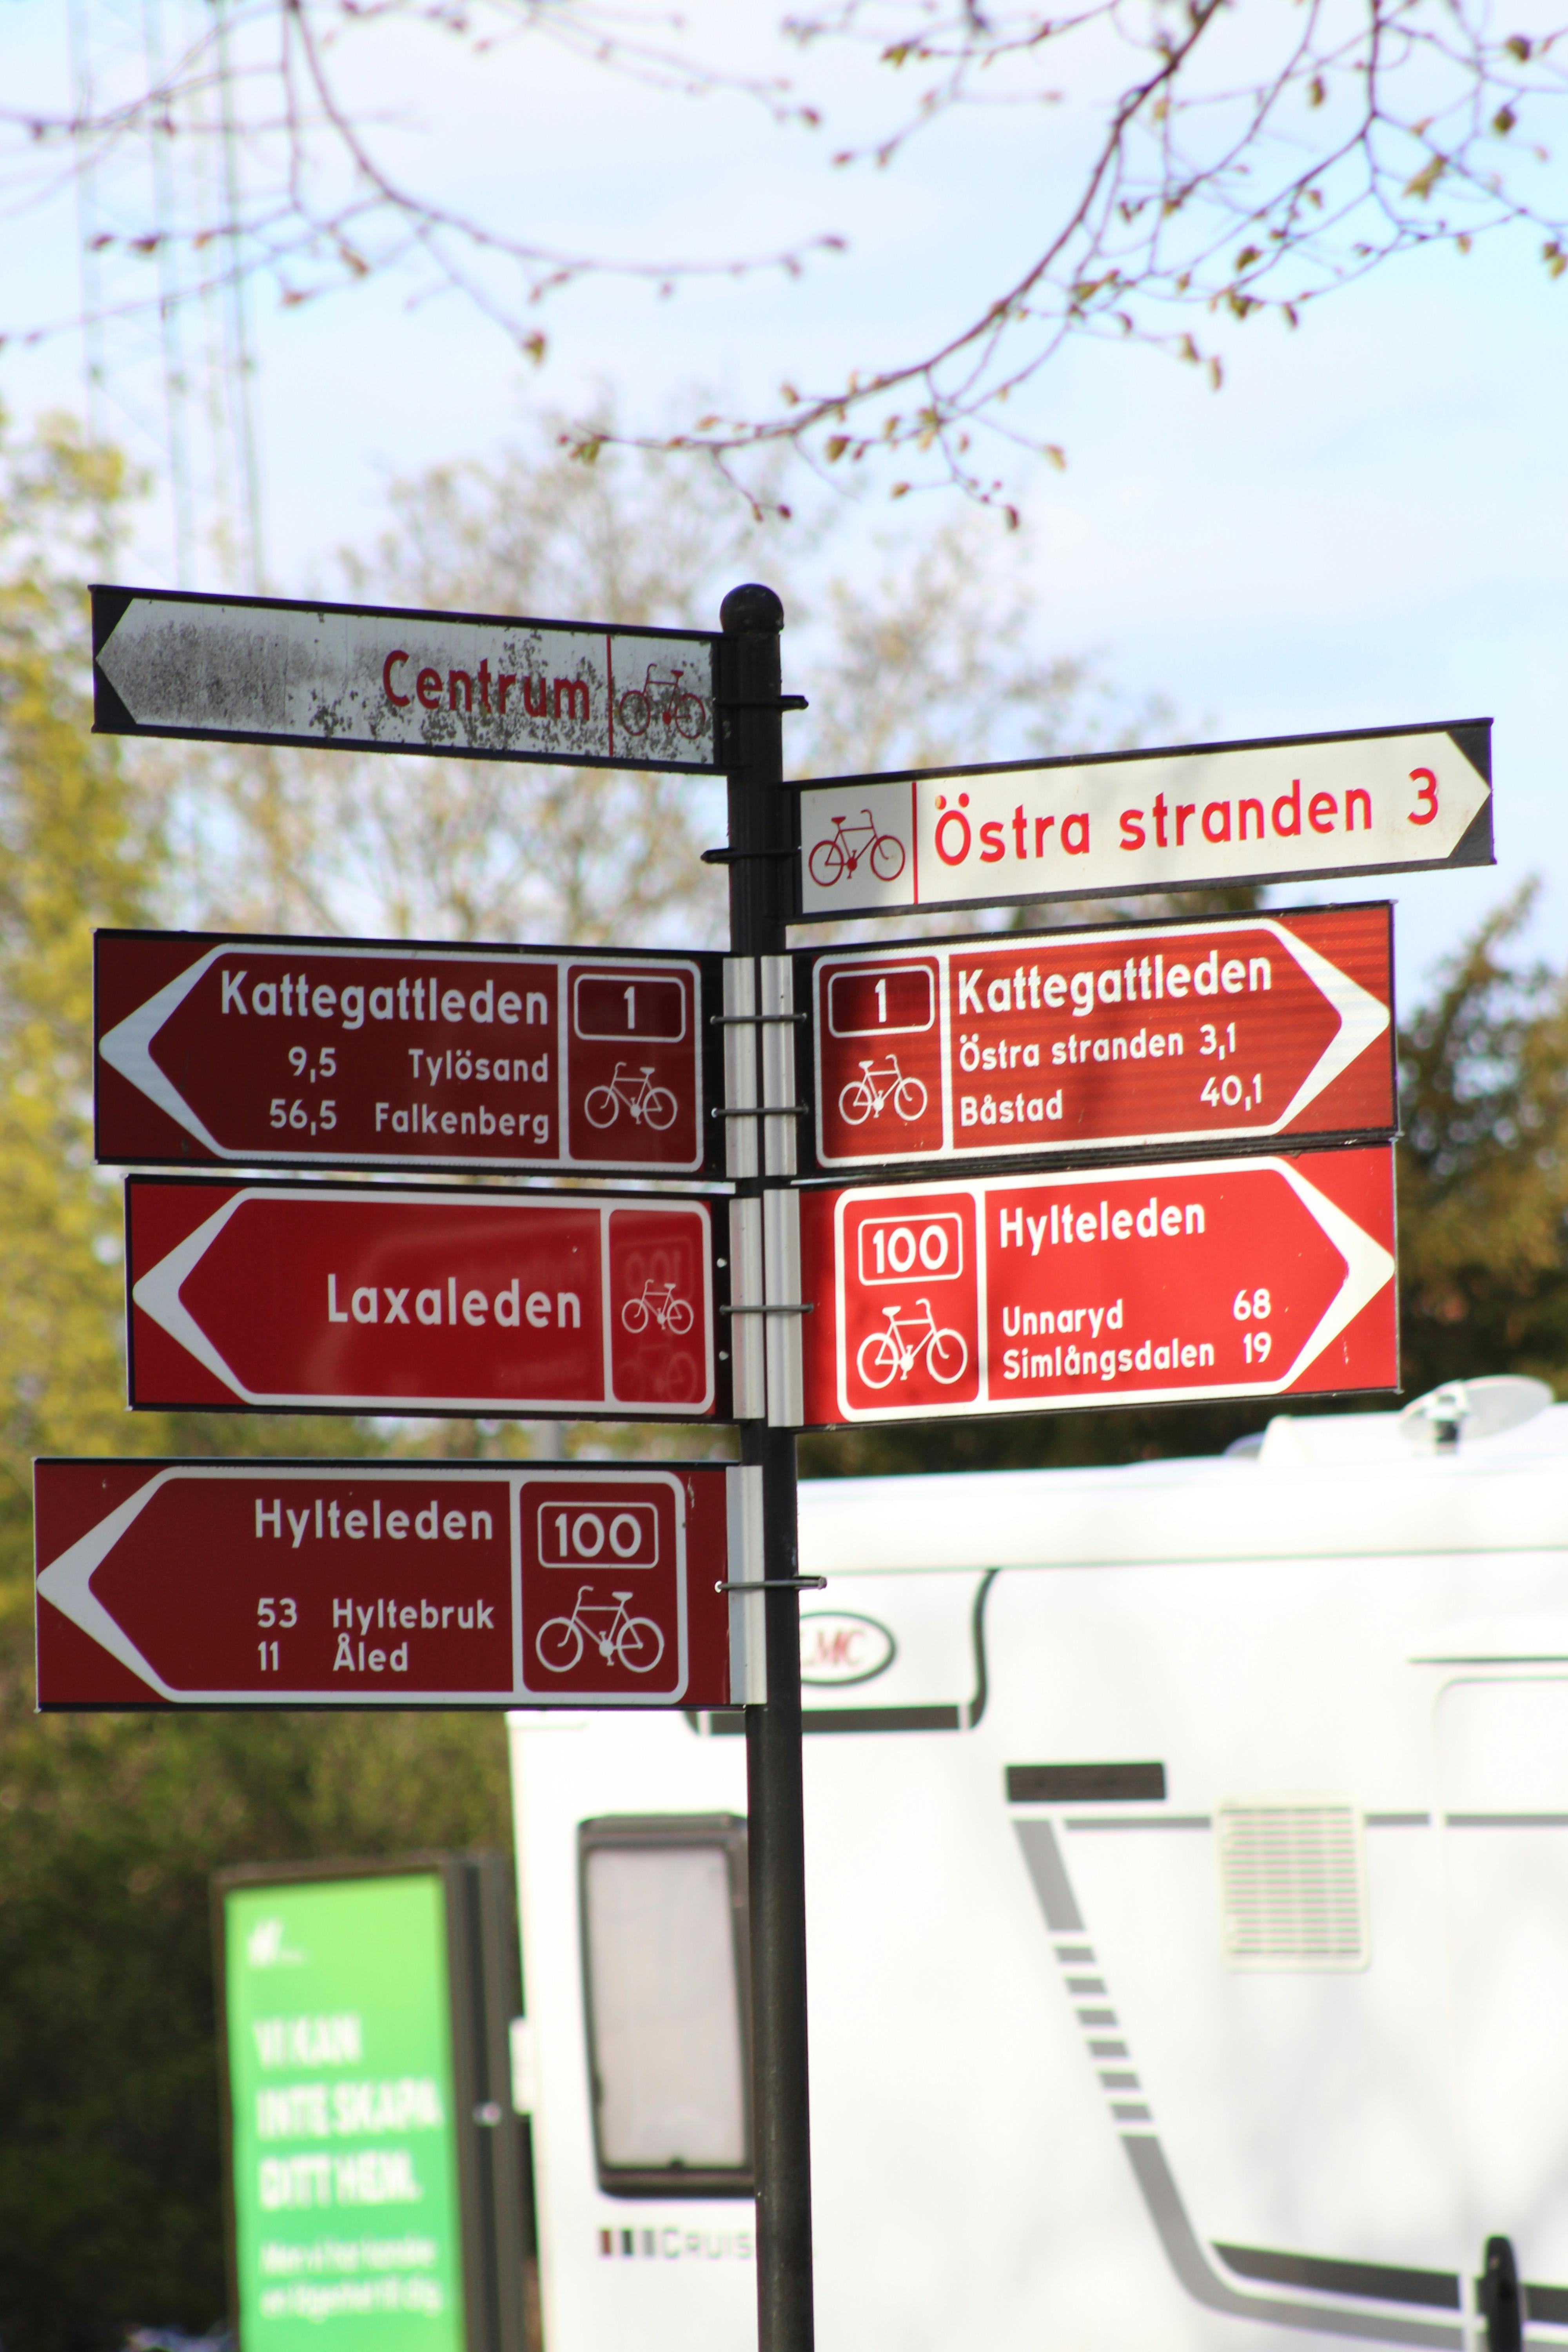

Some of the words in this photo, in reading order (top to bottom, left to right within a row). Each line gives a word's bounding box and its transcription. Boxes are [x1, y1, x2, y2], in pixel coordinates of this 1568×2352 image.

[383, 650, 590, 721] Centrum
[935, 793, 1090, 866] Östra
[1119, 779, 1372, 851] stranden
[1408, 767, 1439, 826] 3
[221, 970, 548, 1030] Kattegattleden
[624, 985, 635, 1029] 1
[875, 978, 887, 1023] 1
[958, 949, 1272, 1017] Kattegattleden
[288, 1045, 337, 1083] 9,5
[408, 1048, 548, 1087] Tylösand
[959, 1033, 1040, 1072] Östra
[1051, 1027, 1184, 1065] stranden
[1200, 1022, 1236, 1060] 3,1
[269, 1098, 337, 1136] 56,5
[375, 1102, 549, 1144] Falkenberg
[960, 1089, 1063, 1127] Båstad
[1200, 1073, 1262, 1111] 40,1
[872, 1223, 949, 1274] 100
[1000, 1196, 1206, 1256] Hylteleden
[327, 1273, 581, 1328] Laxaleden
[1003, 1298, 1123, 1339] Unnaryd
[1233, 1288, 1272, 1321] 68
[1003, 1336, 1215, 1381] Simlångsdalen
[1243, 1331, 1272, 1364] 19
[255, 1498, 493, 1549] Hylteleden
[555, 1513, 642, 1558] 100
[257, 1597, 298, 1628] 53
[332, 1598, 494, 1636] Hyltebruk
[257, 1641, 279, 1671] 11
[332, 1632, 408, 1672] Åled
[662, 2227, 756, 2258] CRUIS
